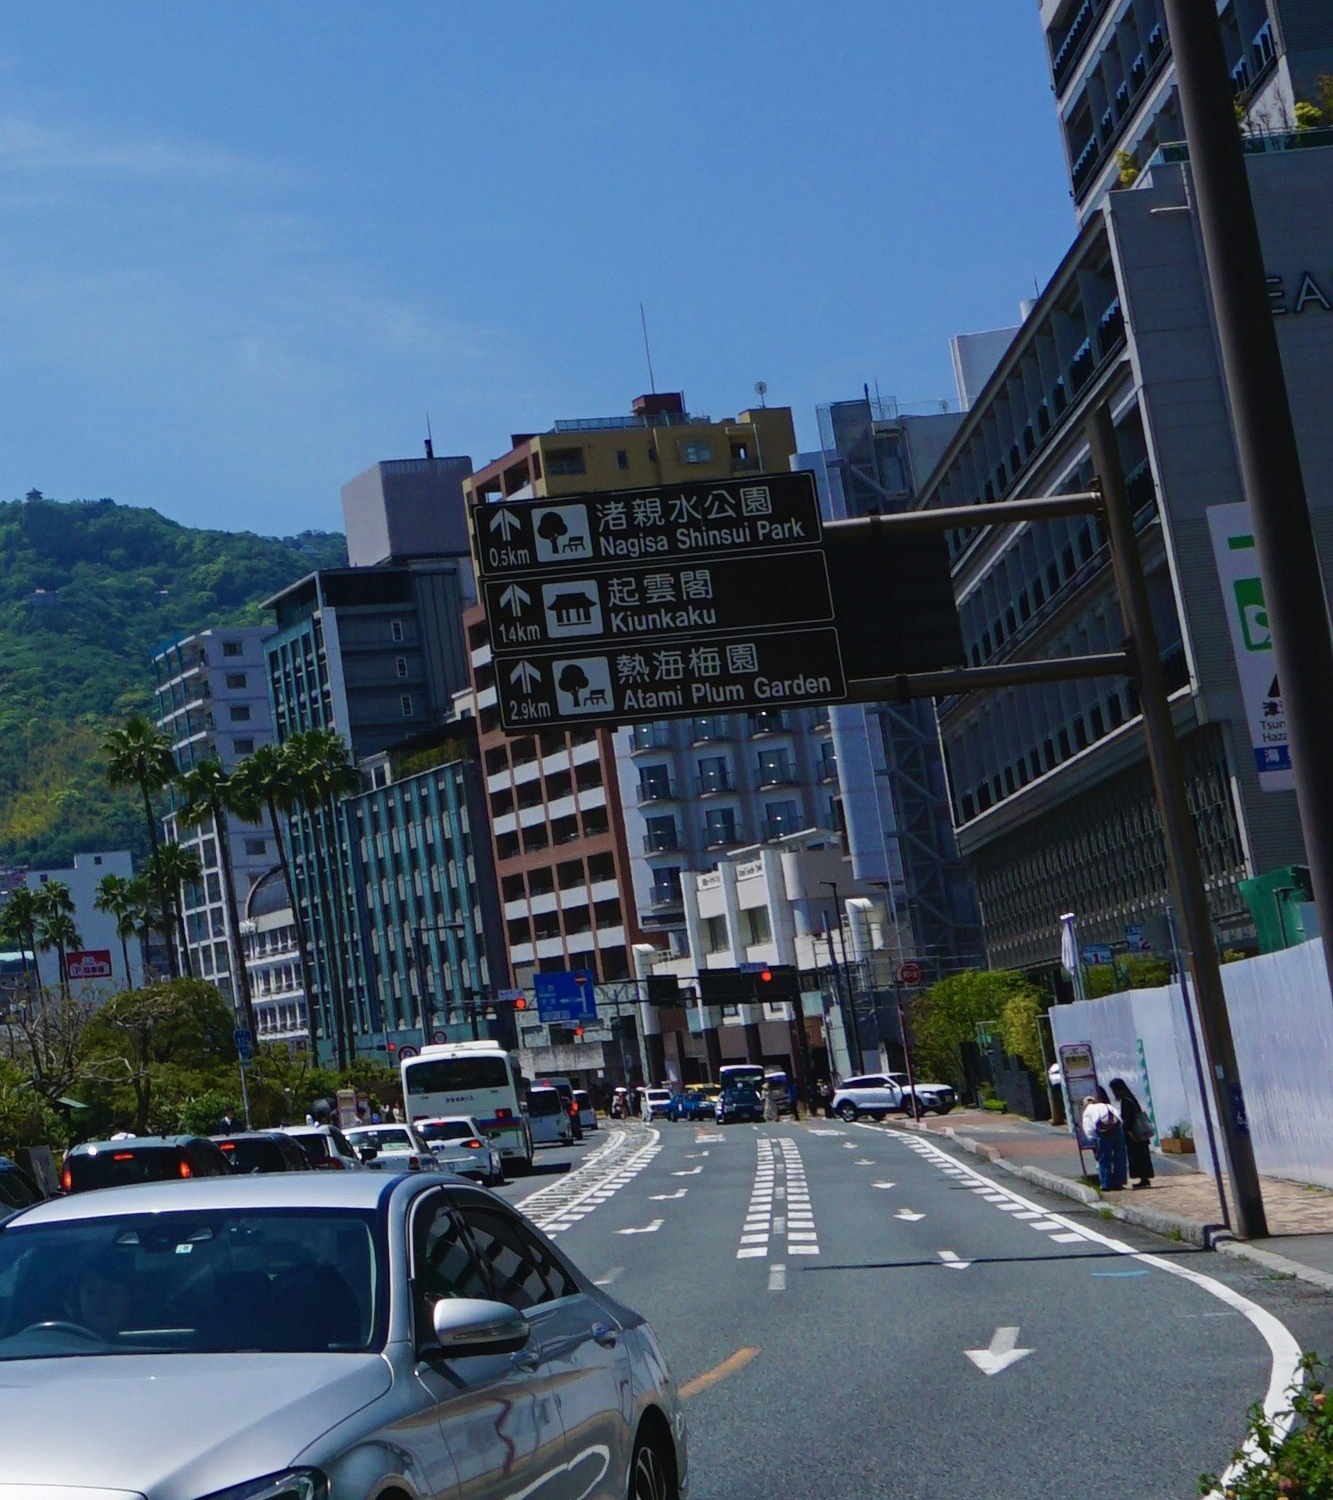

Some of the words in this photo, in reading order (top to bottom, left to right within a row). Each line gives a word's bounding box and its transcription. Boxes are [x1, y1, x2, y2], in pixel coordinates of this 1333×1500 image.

[595, 486, 772, 532] 渚親水公園
[489, 546, 530, 567] 0.5km
[599, 532, 669, 558] Nagisa
[676, 522, 751, 550] Shinsui
[757, 517, 805, 541] Park
[608, 569, 713, 607] 起雲閣
[499, 621, 540, 643] 1.4km
[610, 605, 716, 633] Kiunkaku
[616, 643, 758, 684] 熱海梅園
[510, 699, 551, 721] 2.9km
[624, 685, 683, 711] Atami
[691, 682, 745, 704] Plum
[754, 673, 831, 700] Garden
